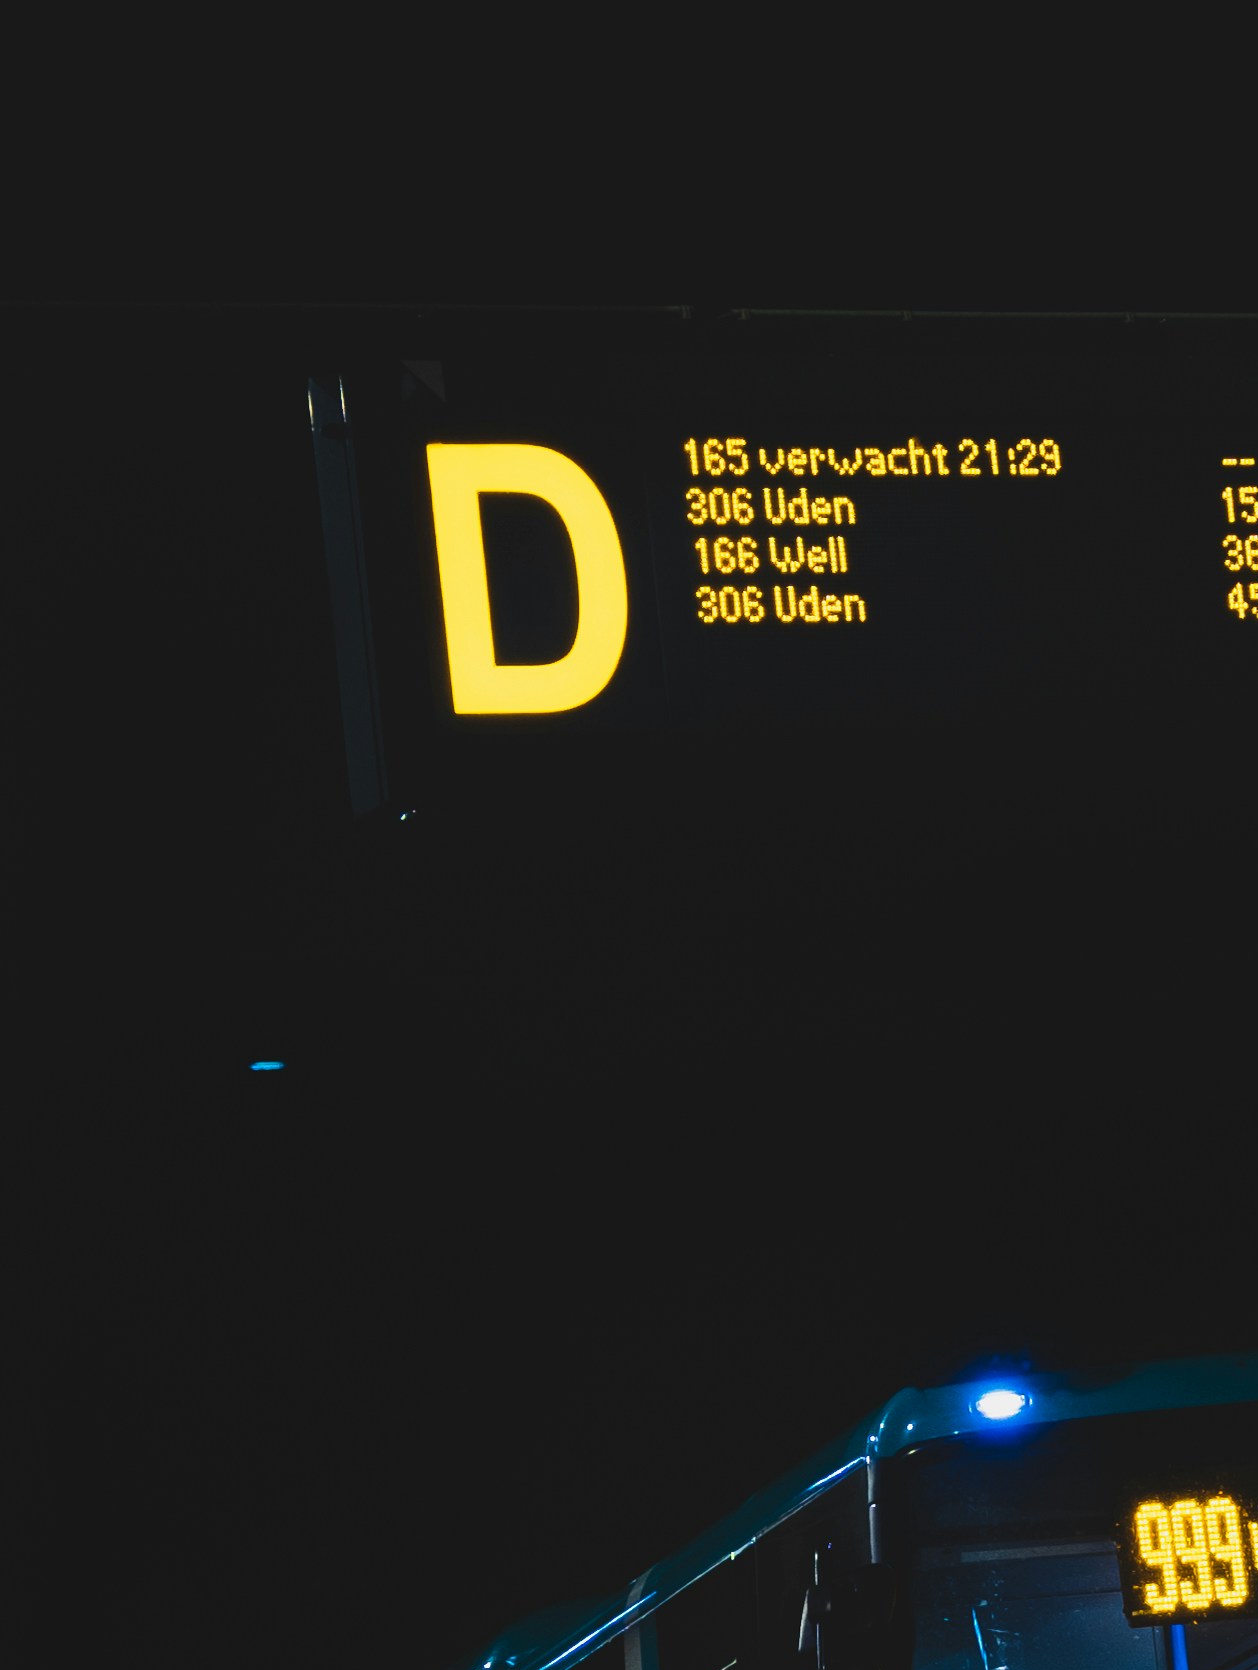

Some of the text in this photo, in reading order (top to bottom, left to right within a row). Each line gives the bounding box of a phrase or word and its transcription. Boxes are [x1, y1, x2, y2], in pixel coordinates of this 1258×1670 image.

[684, 438, 749, 476] 165
[759, 438, 950, 476] verwacht
[958, 439, 1062, 476] 21:29
[686, 487, 754, 525] 306
[762, 488, 856, 525] Uden
[695, 536, 760, 574] 166
[768, 536, 848, 574] Well
[426, 442, 628, 715] D
[696, 586, 765, 623] 306
[773, 586, 866, 623] Uden
[1135, 1497, 1248, 1612] 999
